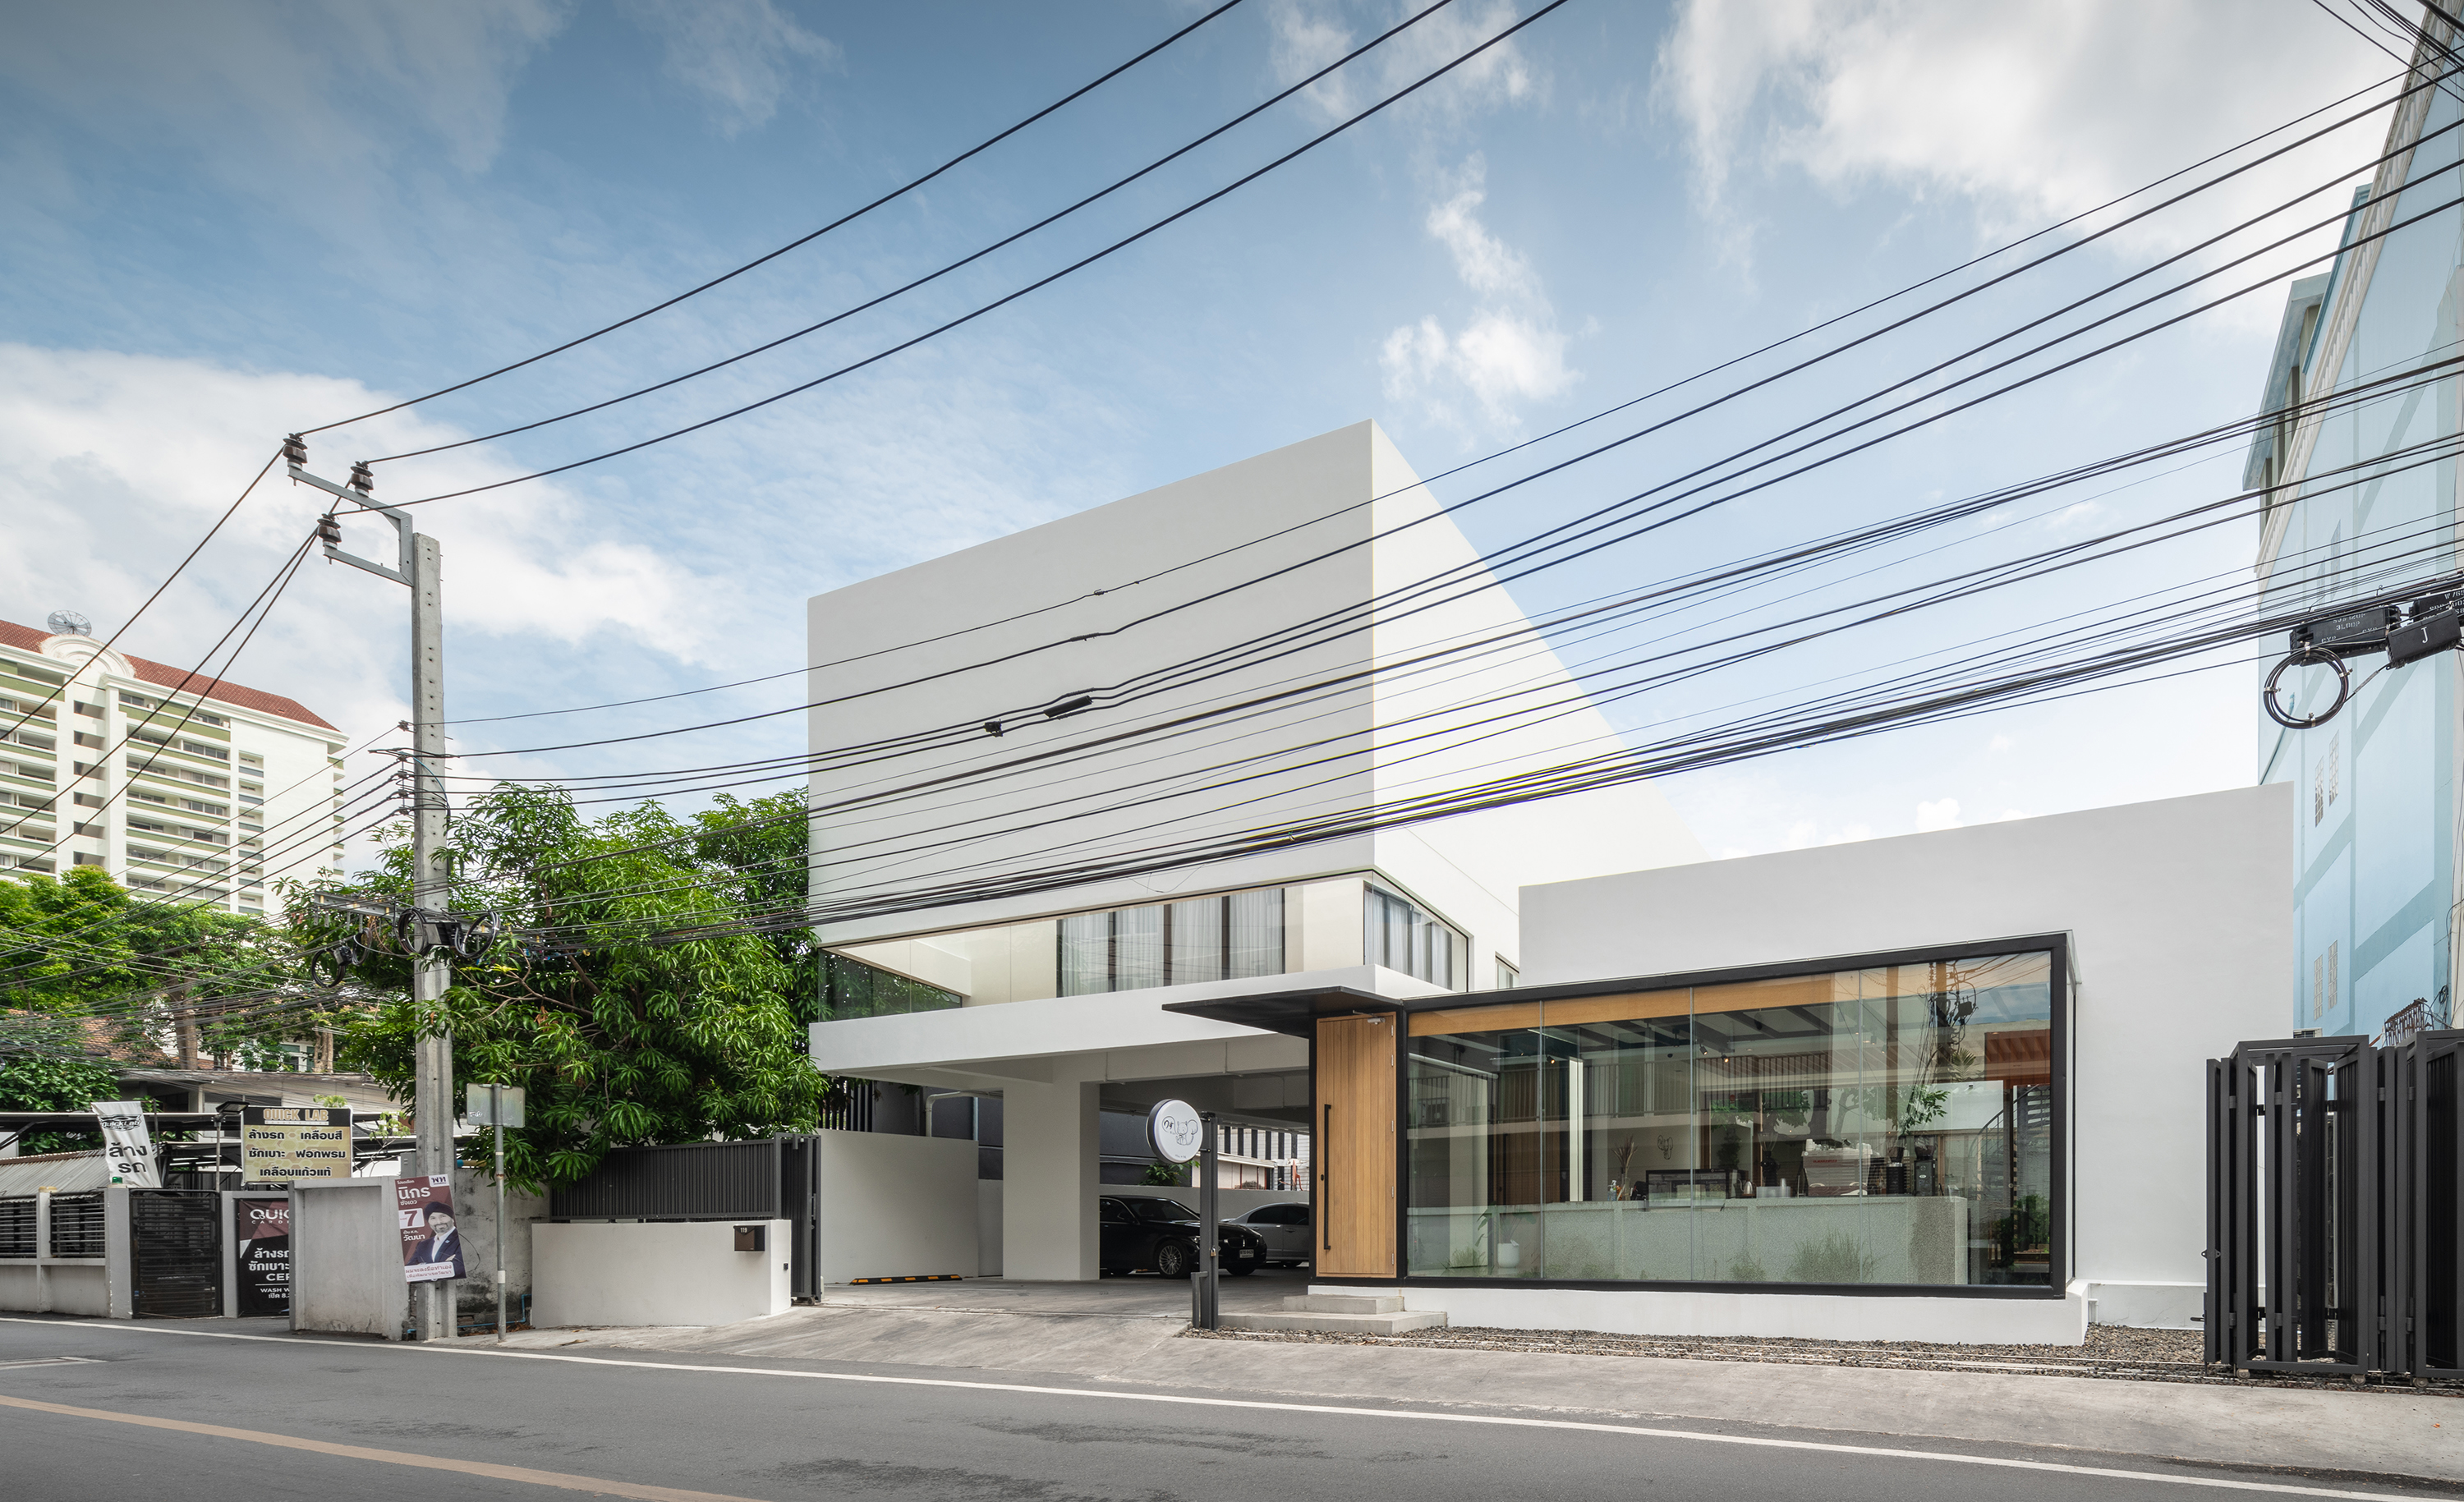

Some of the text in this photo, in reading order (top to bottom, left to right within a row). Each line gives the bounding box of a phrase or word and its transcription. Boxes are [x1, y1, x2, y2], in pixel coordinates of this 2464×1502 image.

[2421, 627, 2429, 644] J
[264, 1109, 329, 1121] QUICK LAB
[248, 1129, 342, 1140] ล้างรถ เคลือบสี
[108, 1142, 148, 1157] ล้าง
[249, 1148, 346, 1158] ซักเบาะ ฟอกพรม
[117, 1162, 146, 1174] รถ
[260, 1167, 332, 1177] เคลือบแก้วแท้
[398, 1187, 431, 1200] นิกร
[404, 1210, 418, 1227] 7
